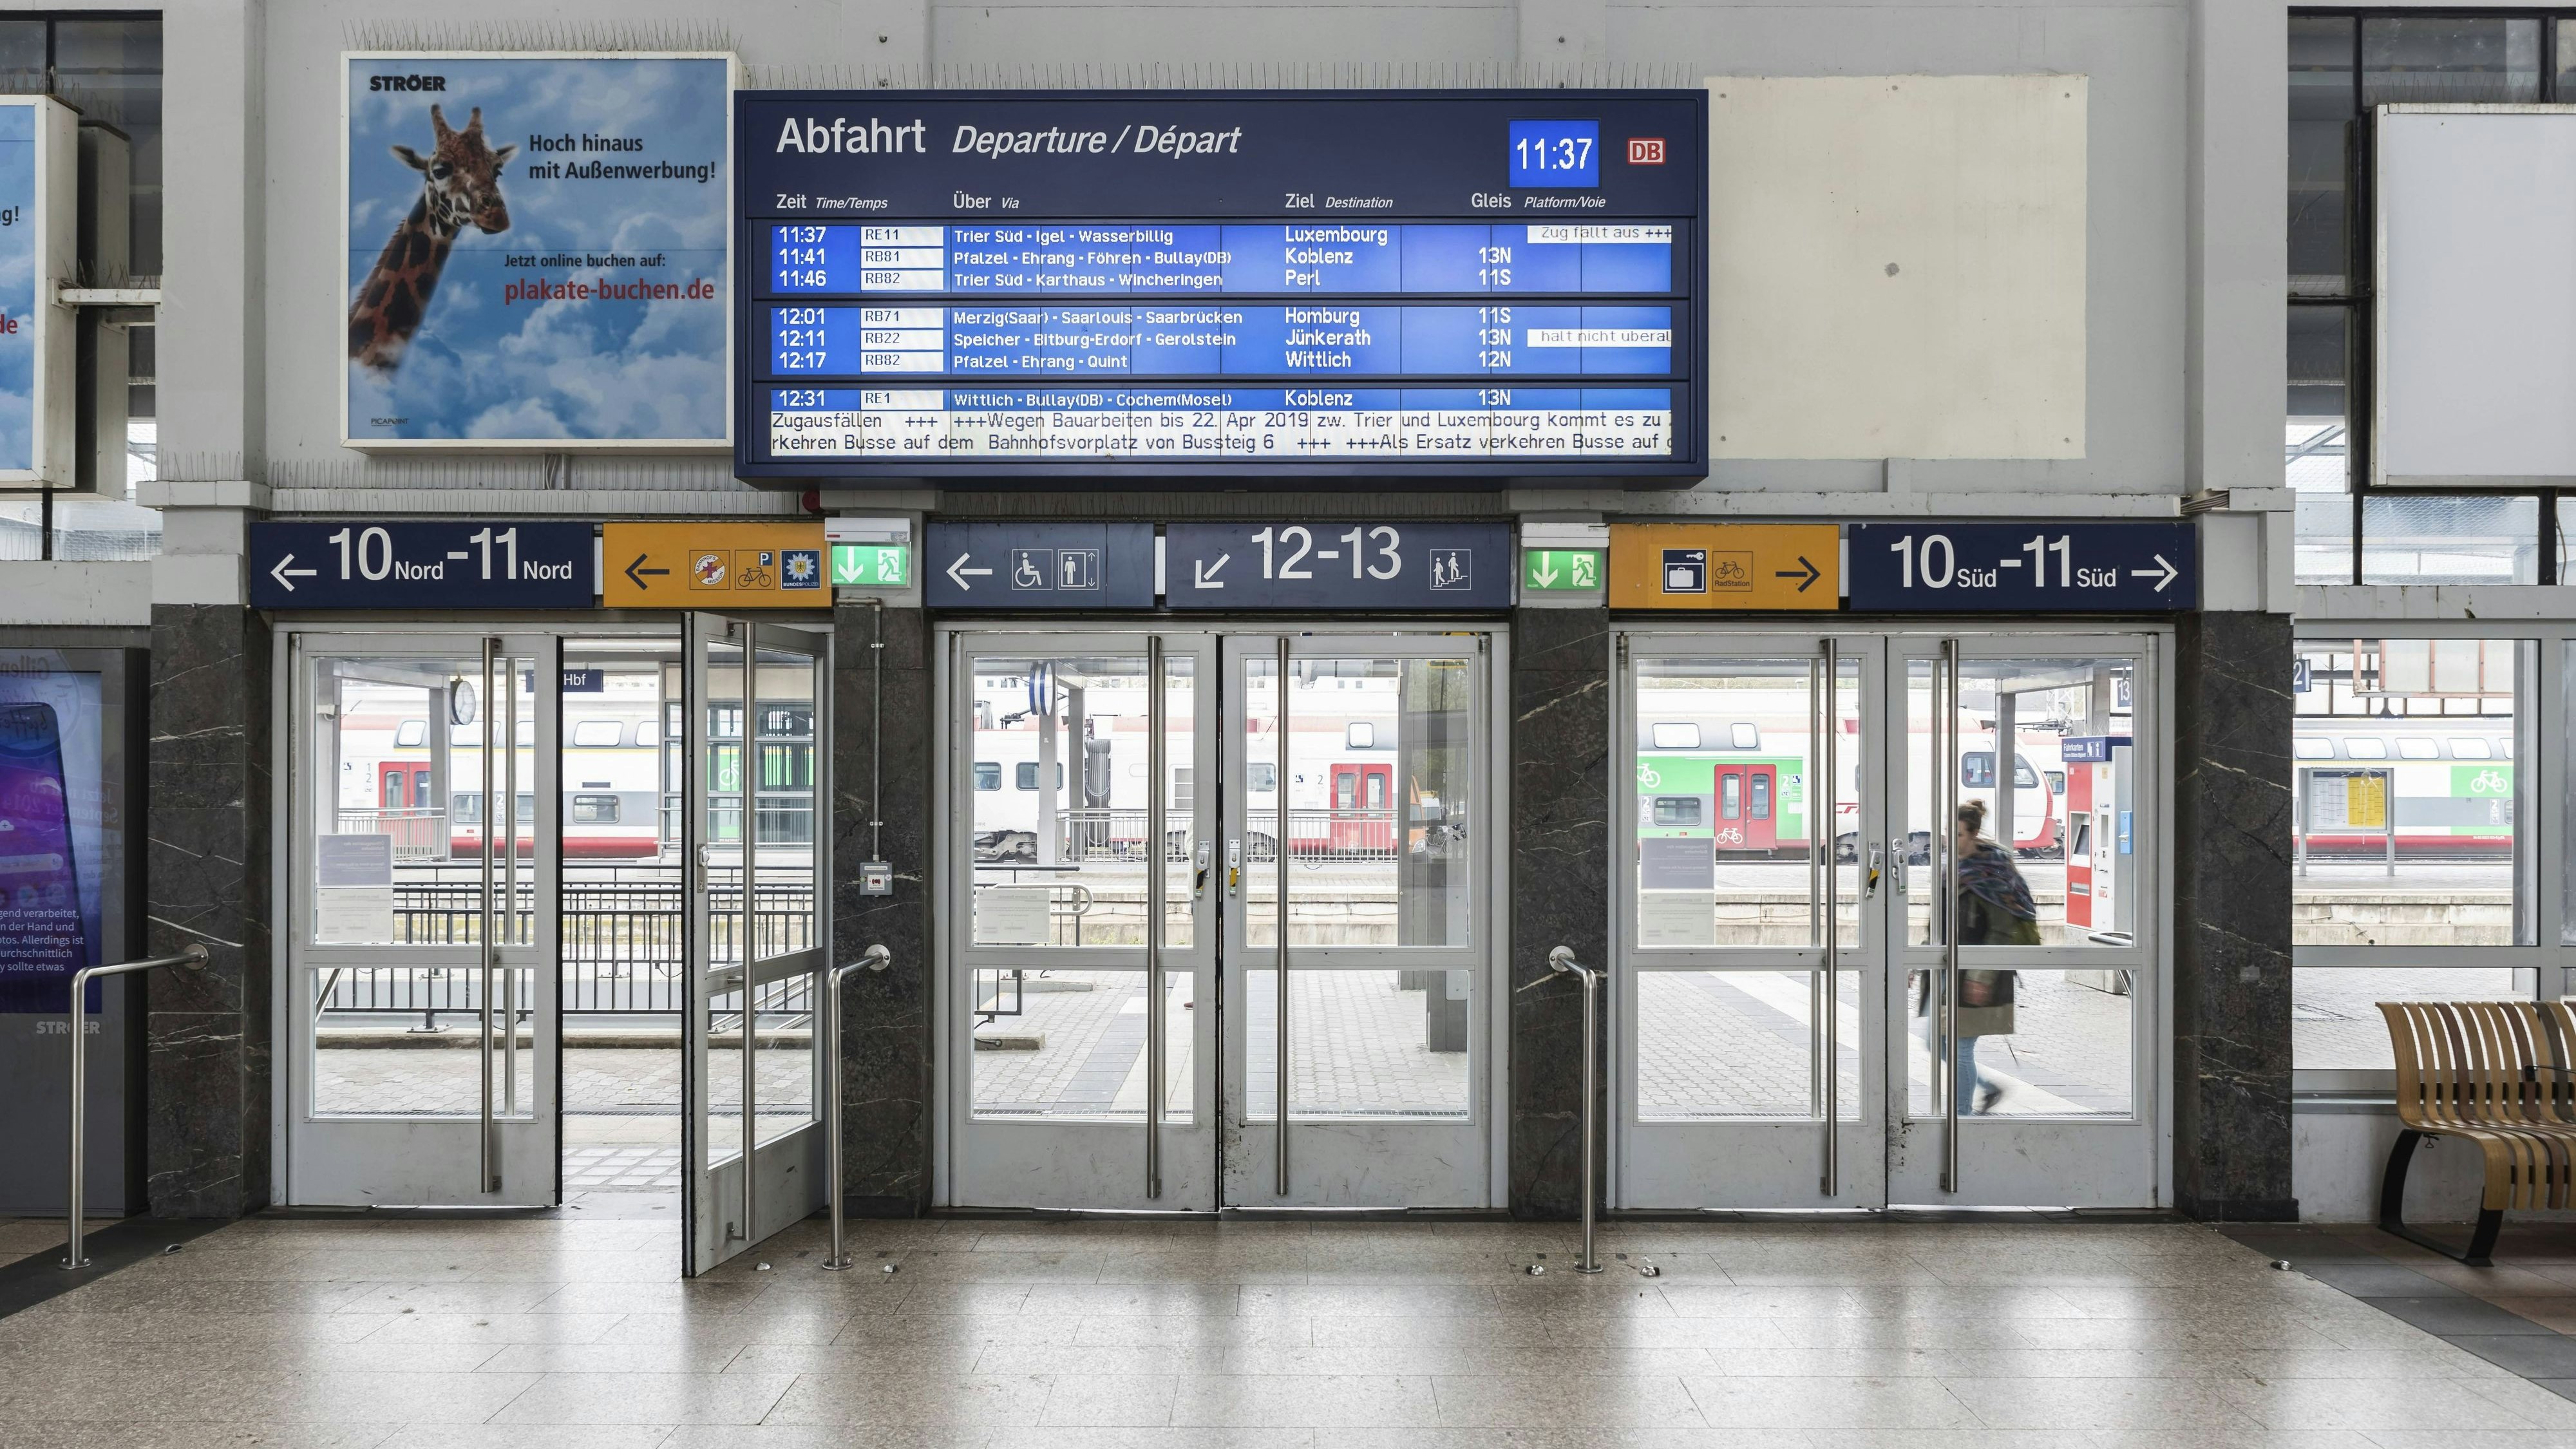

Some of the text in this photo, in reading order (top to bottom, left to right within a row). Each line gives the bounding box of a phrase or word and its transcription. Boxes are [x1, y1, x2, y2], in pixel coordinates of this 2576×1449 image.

[370, 74, 446, 91] STRÖER
[529, 134, 643, 152] Hoch hinaus
[777, 117, 926, 153] Abfahrt
[952, 126, 1106, 159] Departure
[1134, 126, 1242, 159] Départ
[1517, 138, 1592, 169] 11:37
[1632, 143, 1661, 160] DB
[529, 161, 715, 183] mit Außenwerbung!
[776, 193, 888, 211] Zeit Time/Temps
[954, 191, 1019, 209] Über Via
[1285, 193, 1393, 209] Ziel Destination
[1471, 193, 1606, 209] Gleis Platform/Voie
[779, 226, 1388, 245] 11:37 RE11 Trier Süd Igel Wasserbillig Luxembourg
[1542, 227, 1567, 241] Zug
[1613, 229, 1640, 238] aus
[504, 254, 665, 267] Jetzt online buchen auf:
[779, 247, 1511, 267] 11:41 RB81 Pfalzel Ehrang Föhren Bullay(DB) Koblenz 13N
[779, 269, 1511, 289] 11:46 RB82 Trier Süd Karthaus Wincheringen Perl 11S
[504, 278, 714, 305] plakate-buchen.de
[779, 307, 1511, 327] 12:01 RB71 Merzig(Saar) Saarlouis Saarbrücken Homburg 11S
[779, 329, 1511, 348] 12:11 RB22 Speicher Bitburg-Erdorf Gerolstein Jünkerath 13N
[1578, 330, 1616, 342] nicht
[779, 350, 1511, 370] 12:17 RB82 Pfalzel Ehrang Quint Wittlich 12N
[779, 389, 1511, 409] 12:31 RE1 Wittlich Bullay(DB) Cochem(Mosel) Koblenz 13N
[772, 413, 882, 431] Zugausfällen
[1053, 413, 1152, 428] Bauarbeiten
[1160, 413, 1184, 428] bis
[1192, 413, 1218, 428] 22.
[1227, 413, 1256, 431] Apr
[1264, 413, 1309, 428] 2019
[1317, 416, 1346, 428] zw.
[1354, 412, 1392, 427] Trier
[1402, 412, 1430, 426] und
[1438, 412, 1540, 430] Luxembourg
[1548, 412, 1607, 426] kommt
[1615, 416, 1634, 426] es
[1643, 416, 1661, 426] zu
[772, 435, 837, 450] rkehren
[844, 435, 896, 450] Busse
[904, 435, 931, 450] auf
[938, 435, 974, 450] dem
[989, 435, 1138, 452] Bahnhofsvorplatz
[1146, 438, 1174, 450] von
[1182, 435, 1256, 453] Bussteig
[1264, 435, 1274, 449] 6
[1417, 433, 1471, 449] Ersatz
[1479, 433, 1565, 449] verkehren
[1572, 433, 1624, 449] Busse
[1632, 433, 1659, 449] auf
[329, 527, 393, 581] 10
[395, 561, 444, 580] Nord
[524, 561, 572, 580] Nord
[760, 553, 770, 565] P
[1251, 526, 1402, 580] 12-13
[1891, 535, 1955, 589] 10
[1957, 569, 1996, 588] Süd
[2077, 569, 2116, 588] Süd
[696, 555, 717, 573] BAHNHOFS
[707, 571, 724, 585] MISSION
[564, 674, 587, 686] Hbf
[2118, 681, 2130, 701] 13
[366, 773, 372, 782] 2
[1318, 775, 1323, 785] 2
[23, 909, 79, 919] verarbeitet,
[8, 922, 75, 931] der Hand und
[22, 935, 70, 946] Allerdings
[72, 936, 84, 944] ist
[1, 948, 73, 958] urchschnittlich
[7, 961, 65, 971] sollte etwas
[36, 1021, 100, 1034] STRER
